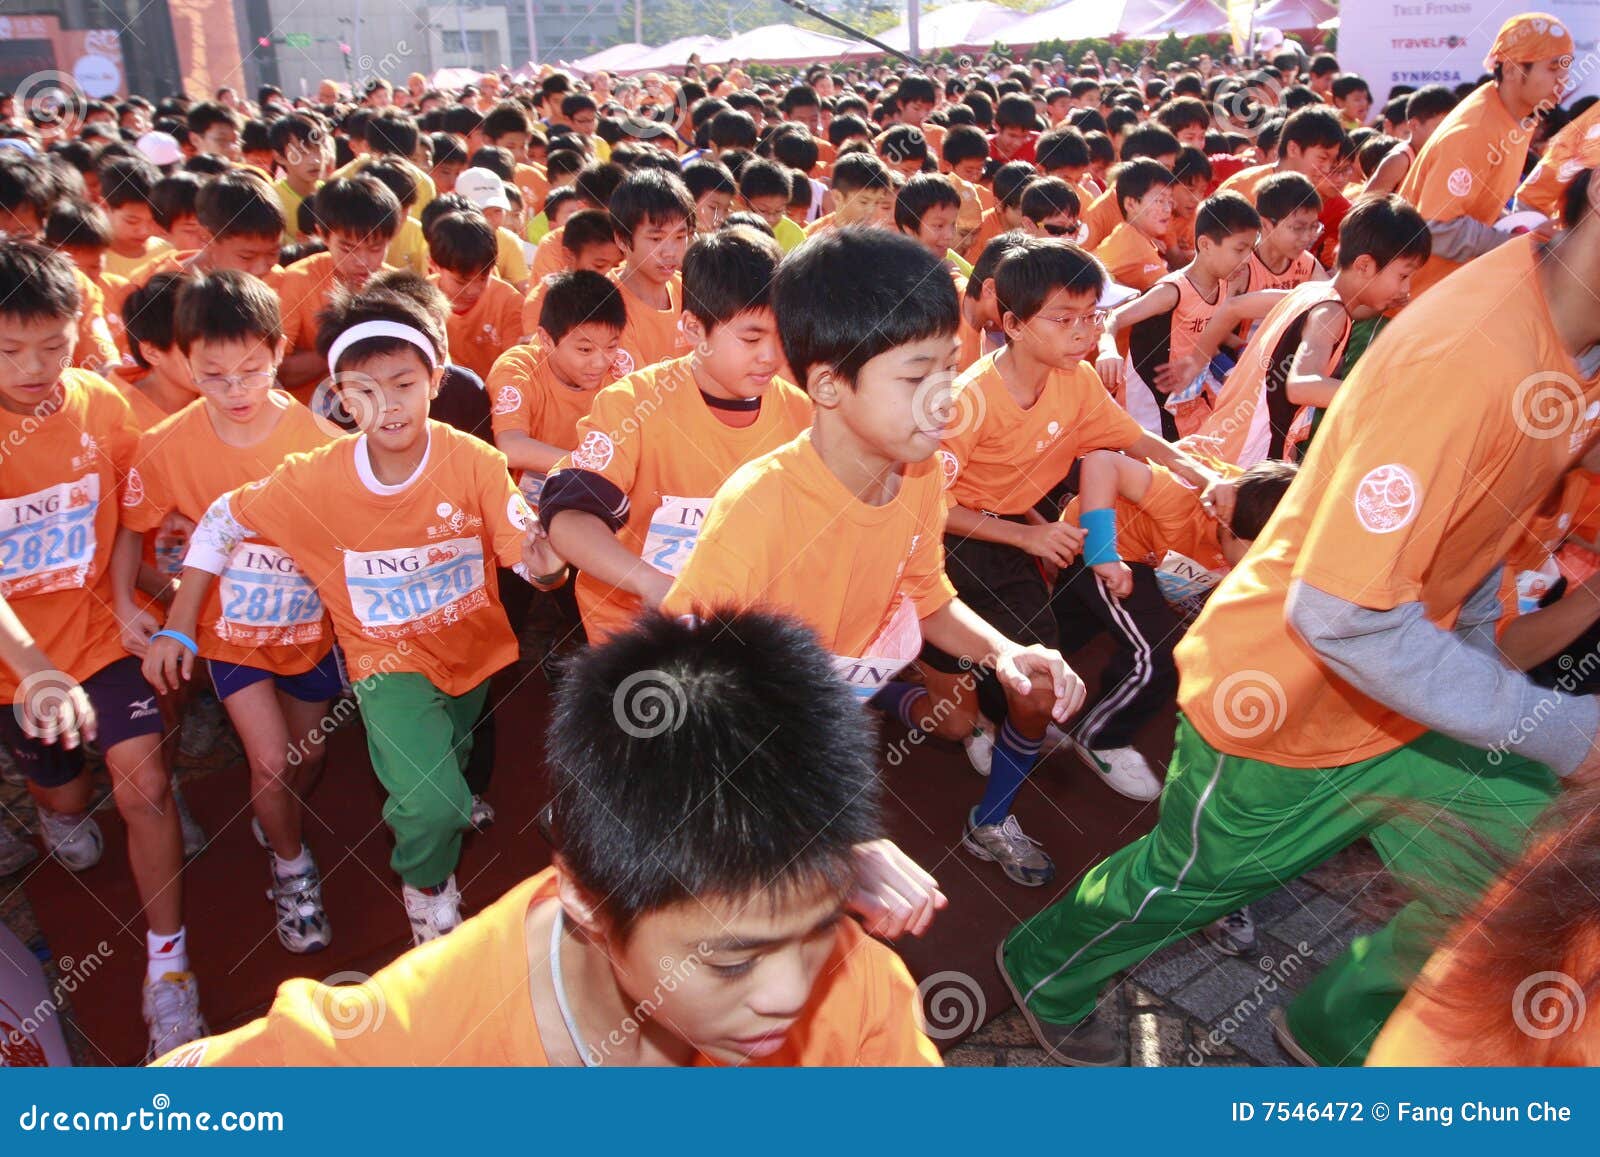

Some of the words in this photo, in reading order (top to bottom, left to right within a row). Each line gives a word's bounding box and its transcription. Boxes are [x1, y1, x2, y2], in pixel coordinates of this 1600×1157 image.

[14, 494, 60, 524] ING
[246, 552, 294, 573] ING
[364, 556, 419, 575] ING
[1173, 562, 1212, 583] ING
[364, 565, 473, 622] 28020
[846, 664, 893, 684] IN
